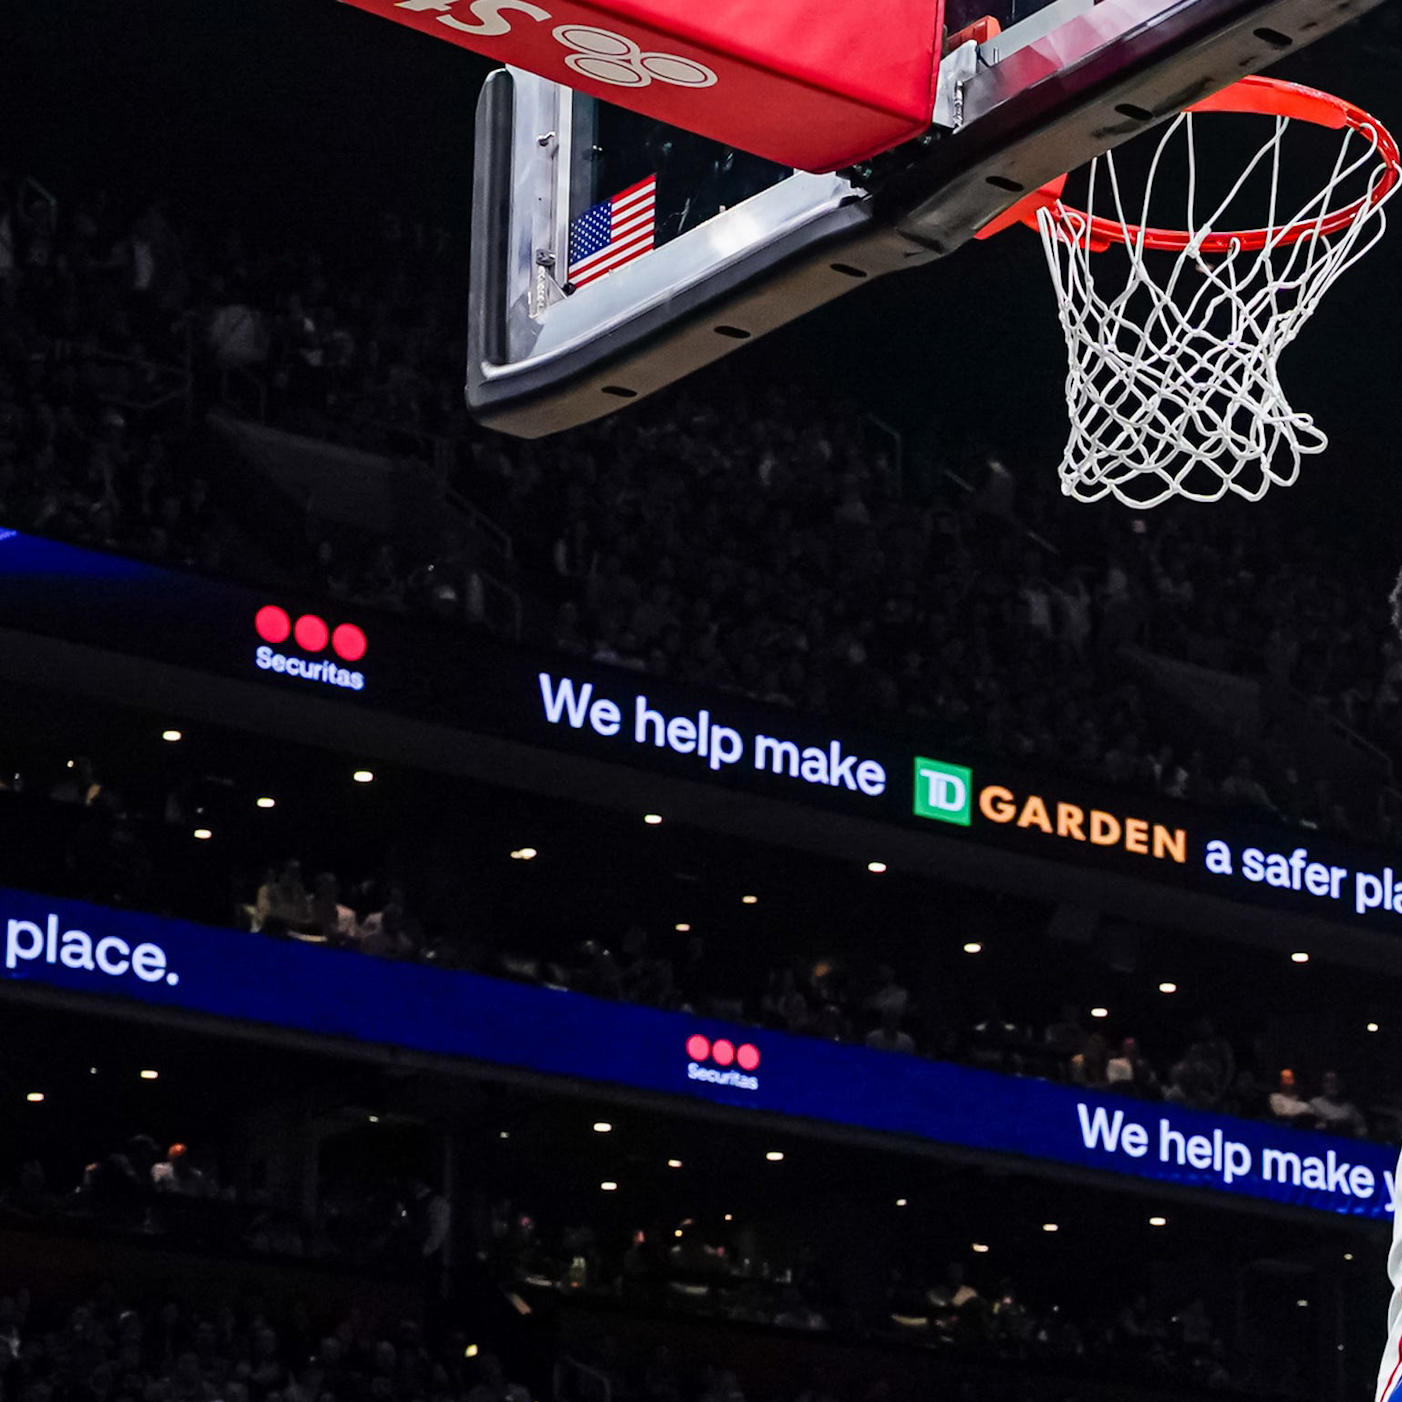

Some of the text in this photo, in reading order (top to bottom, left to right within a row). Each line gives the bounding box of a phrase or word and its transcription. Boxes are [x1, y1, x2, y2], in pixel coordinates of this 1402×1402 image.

[255, 644, 365, 691] Securitas
[538, 672, 622, 737] We
[634, 695, 744, 771] help
[754, 734, 887, 796] make
[919, 768, 967, 813] TD
[978, 784, 1188, 864] GARDEN
[1205, 839, 1233, 875] a
[1242, 847, 1348, 899] safer
[5, 912, 180, 987] place.
[686, 1060, 760, 1091] Securitas
[1076, 1102, 1150, 1159] We
[1158, 1117, 1253, 1185] help
[1262, 1150, 1376, 1200] make
